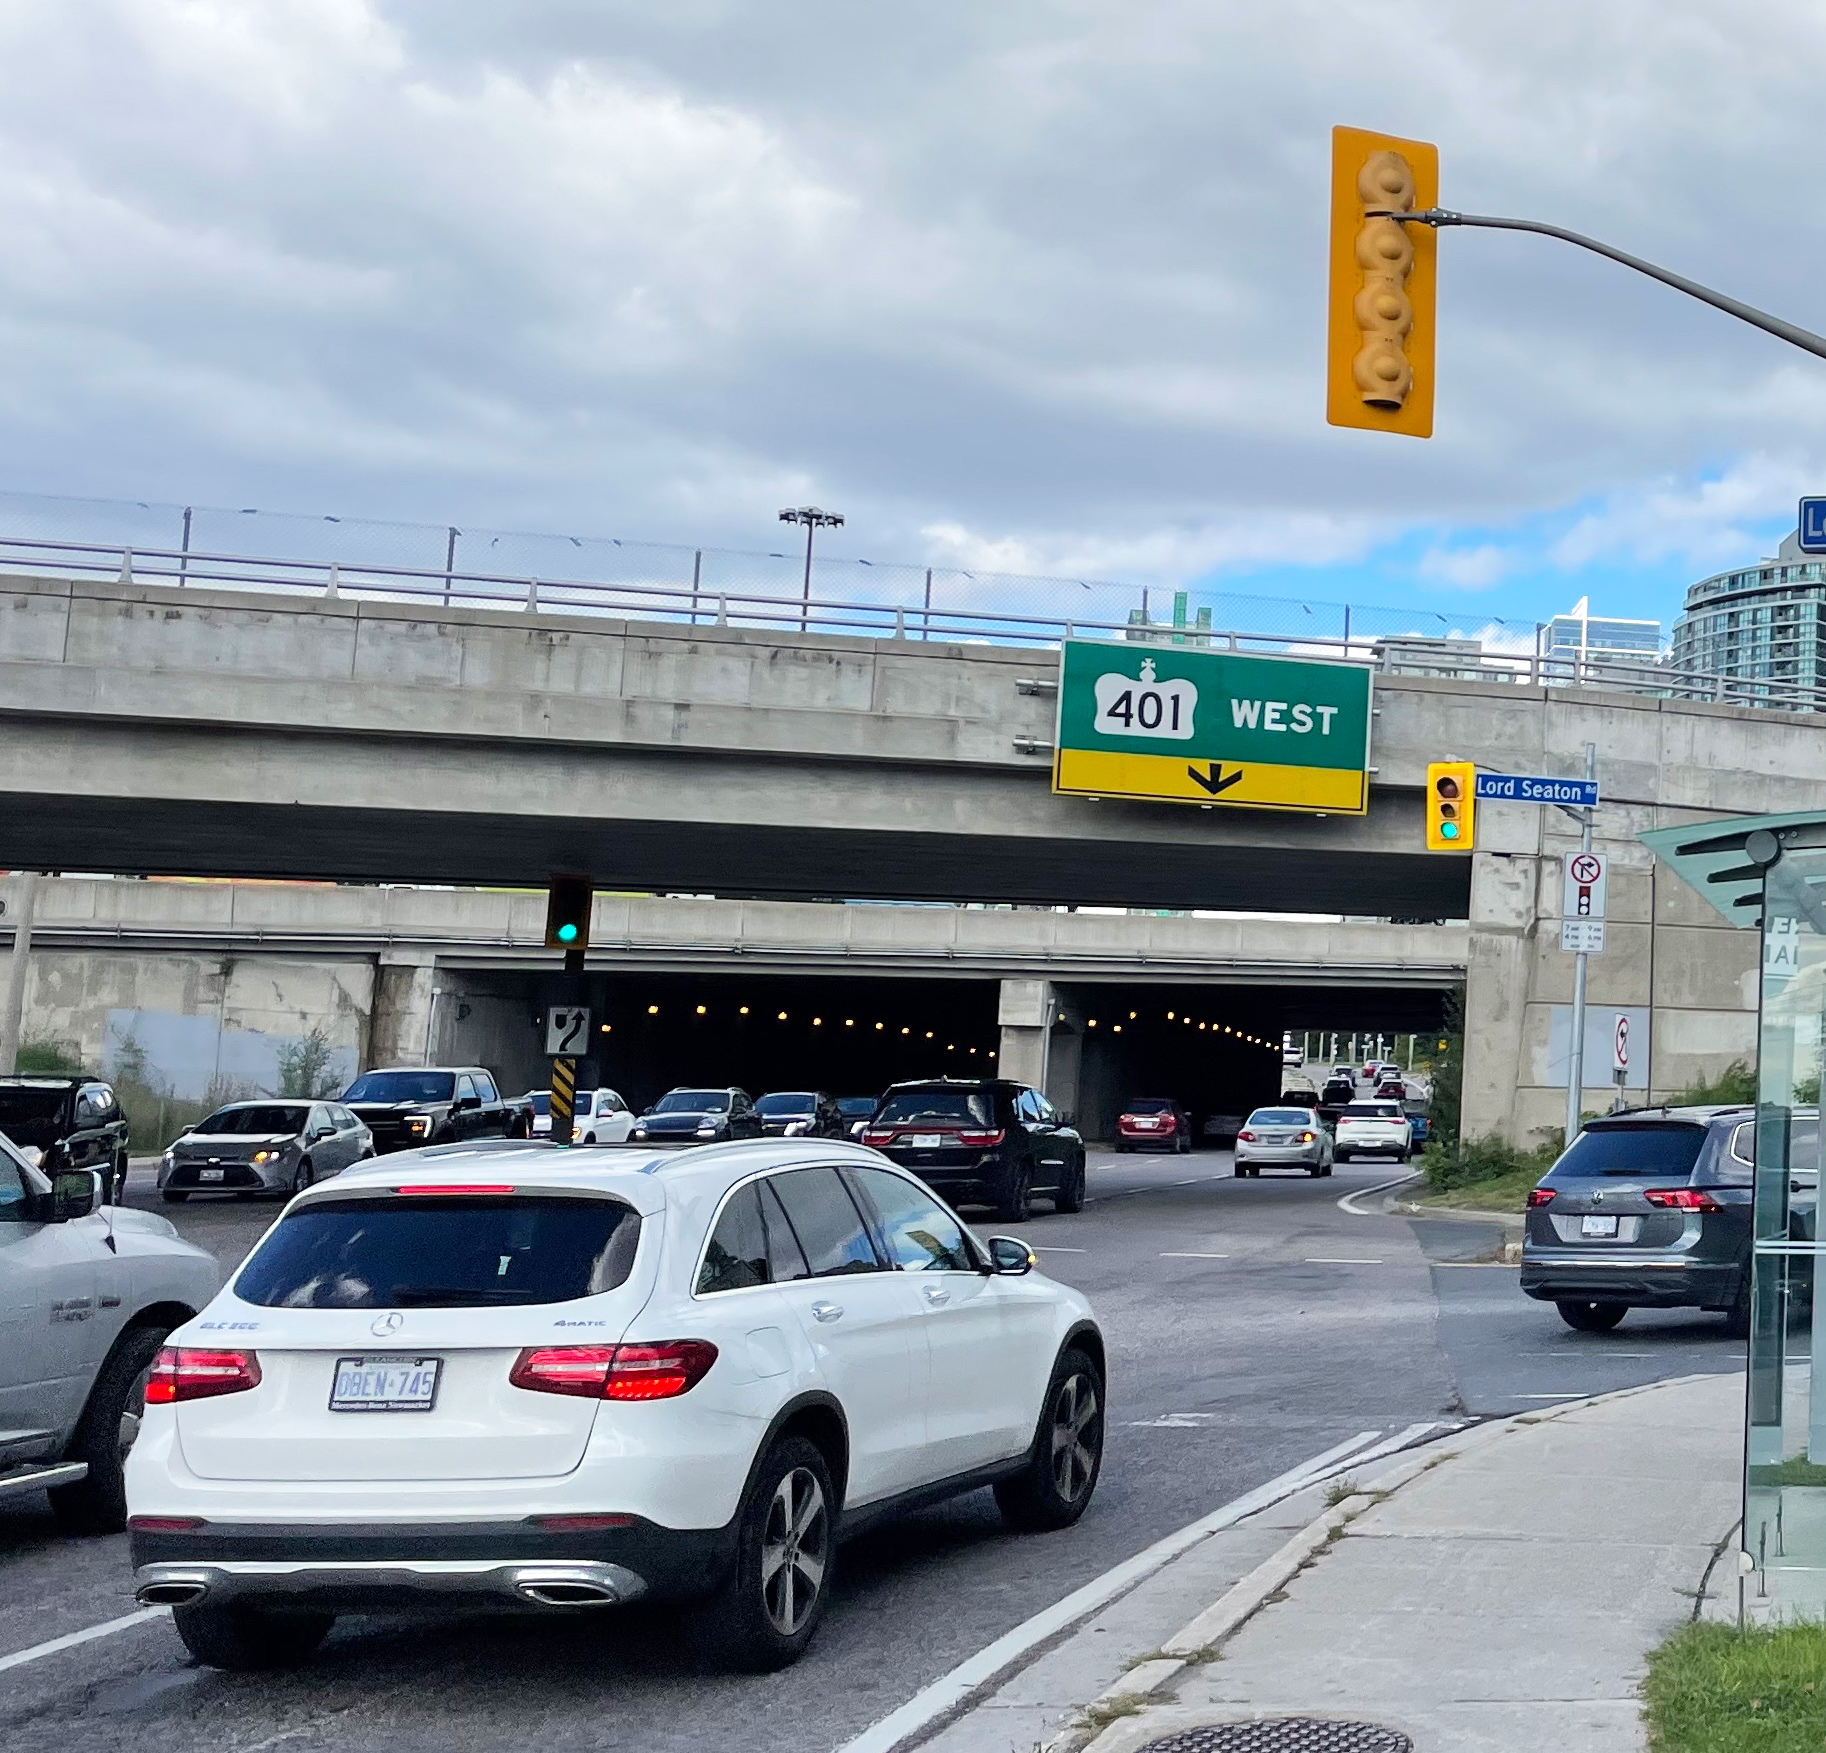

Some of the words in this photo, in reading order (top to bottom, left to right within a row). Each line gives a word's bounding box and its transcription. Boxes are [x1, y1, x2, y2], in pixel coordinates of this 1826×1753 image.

[1808, 507, 1826, 537] L
[1106, 690, 1180, 731] 401
[1231, 698, 1338, 735] WEST
[1477, 777, 1515, 796] Lord
[1521, 780, 1581, 801] Seaton
